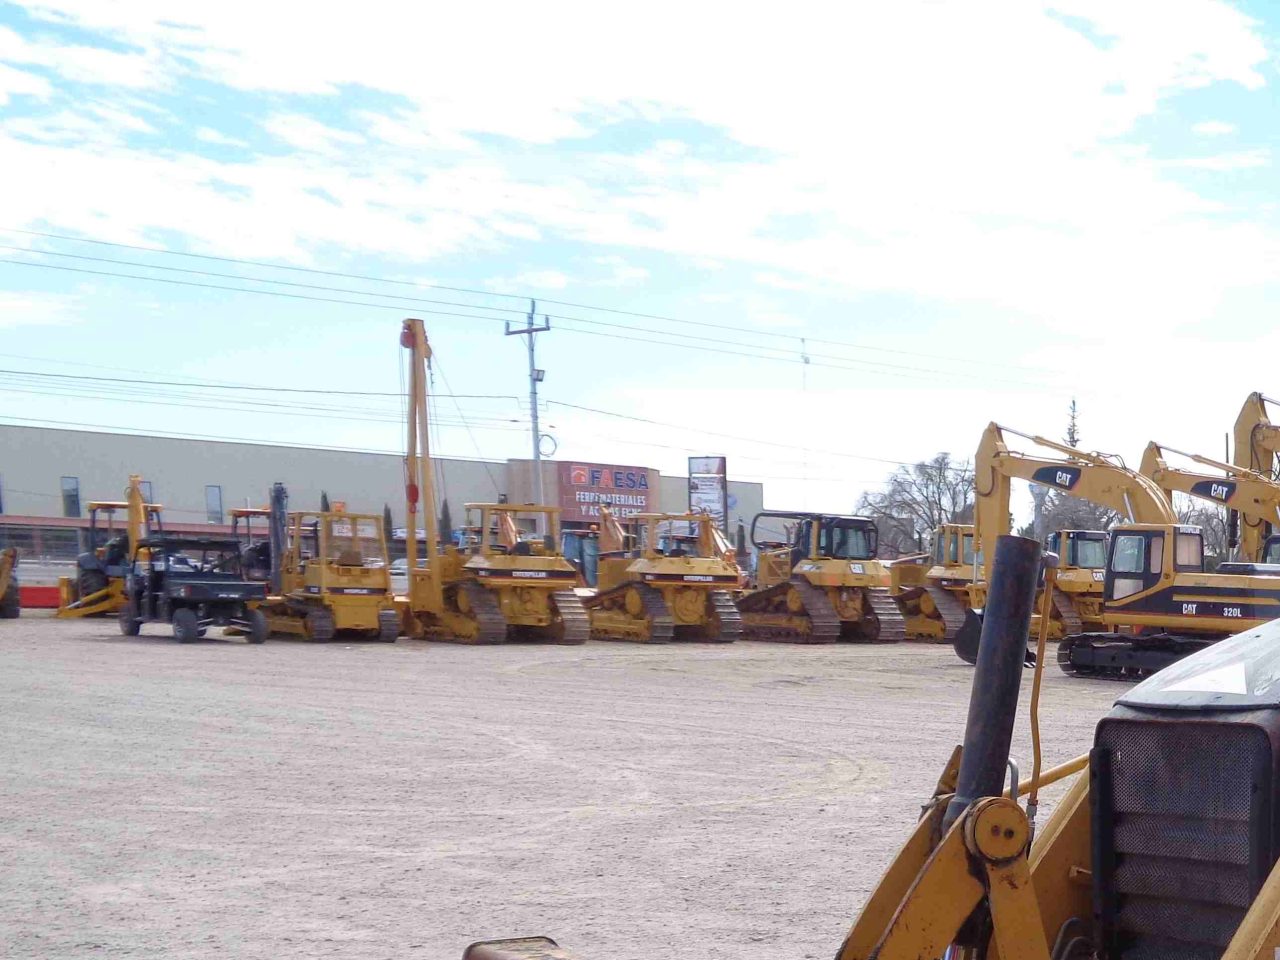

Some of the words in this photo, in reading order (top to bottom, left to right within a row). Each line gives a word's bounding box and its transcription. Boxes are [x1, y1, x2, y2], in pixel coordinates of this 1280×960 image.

[591, 468, 649, 489] FAESA
[1056, 471, 1072, 486] CAT
[1211, 483, 1228, 500] CAT
[1182, 603, 1197, 615] CAT
[1223, 607, 1242, 617] 320L
